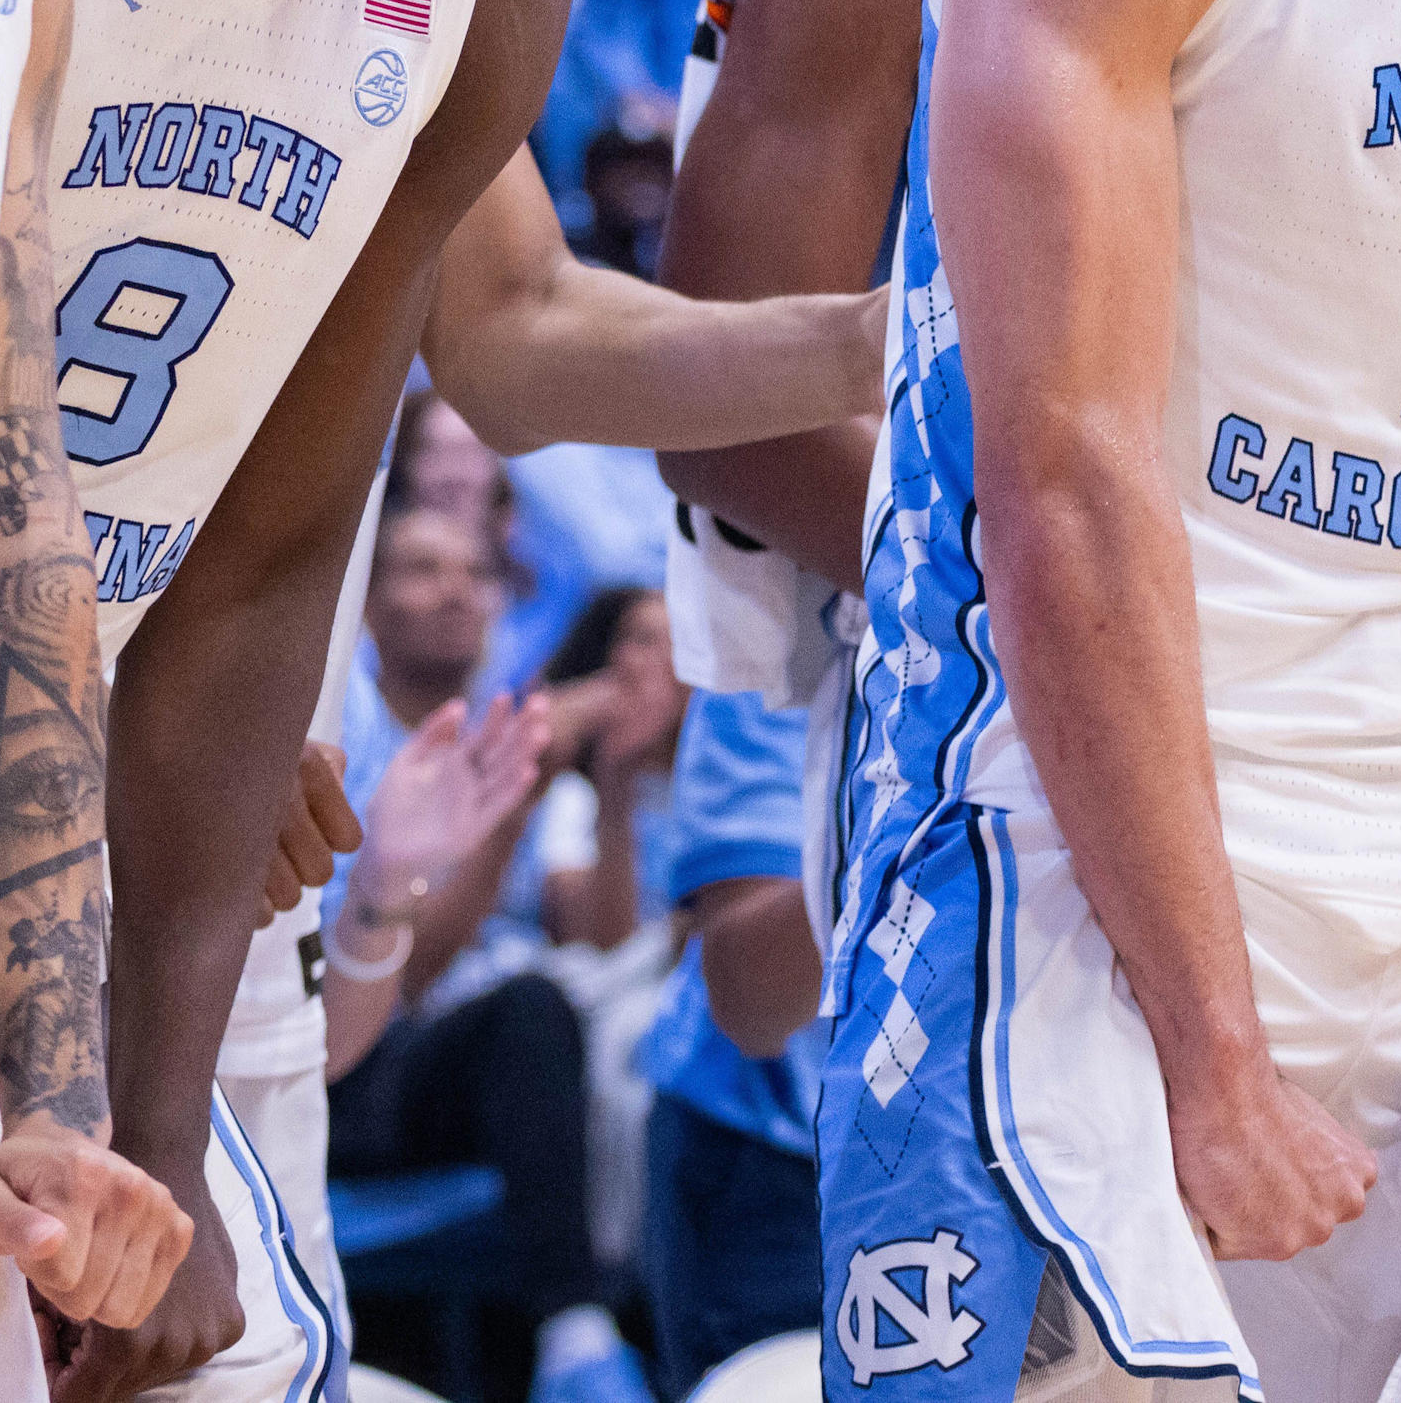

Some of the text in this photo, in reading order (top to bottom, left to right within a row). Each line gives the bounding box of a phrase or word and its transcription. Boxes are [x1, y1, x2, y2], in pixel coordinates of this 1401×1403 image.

[364, 74, 406, 97] ACC
[62, 102, 341, 240] NORTH
[56, 237, 235, 466] 8
